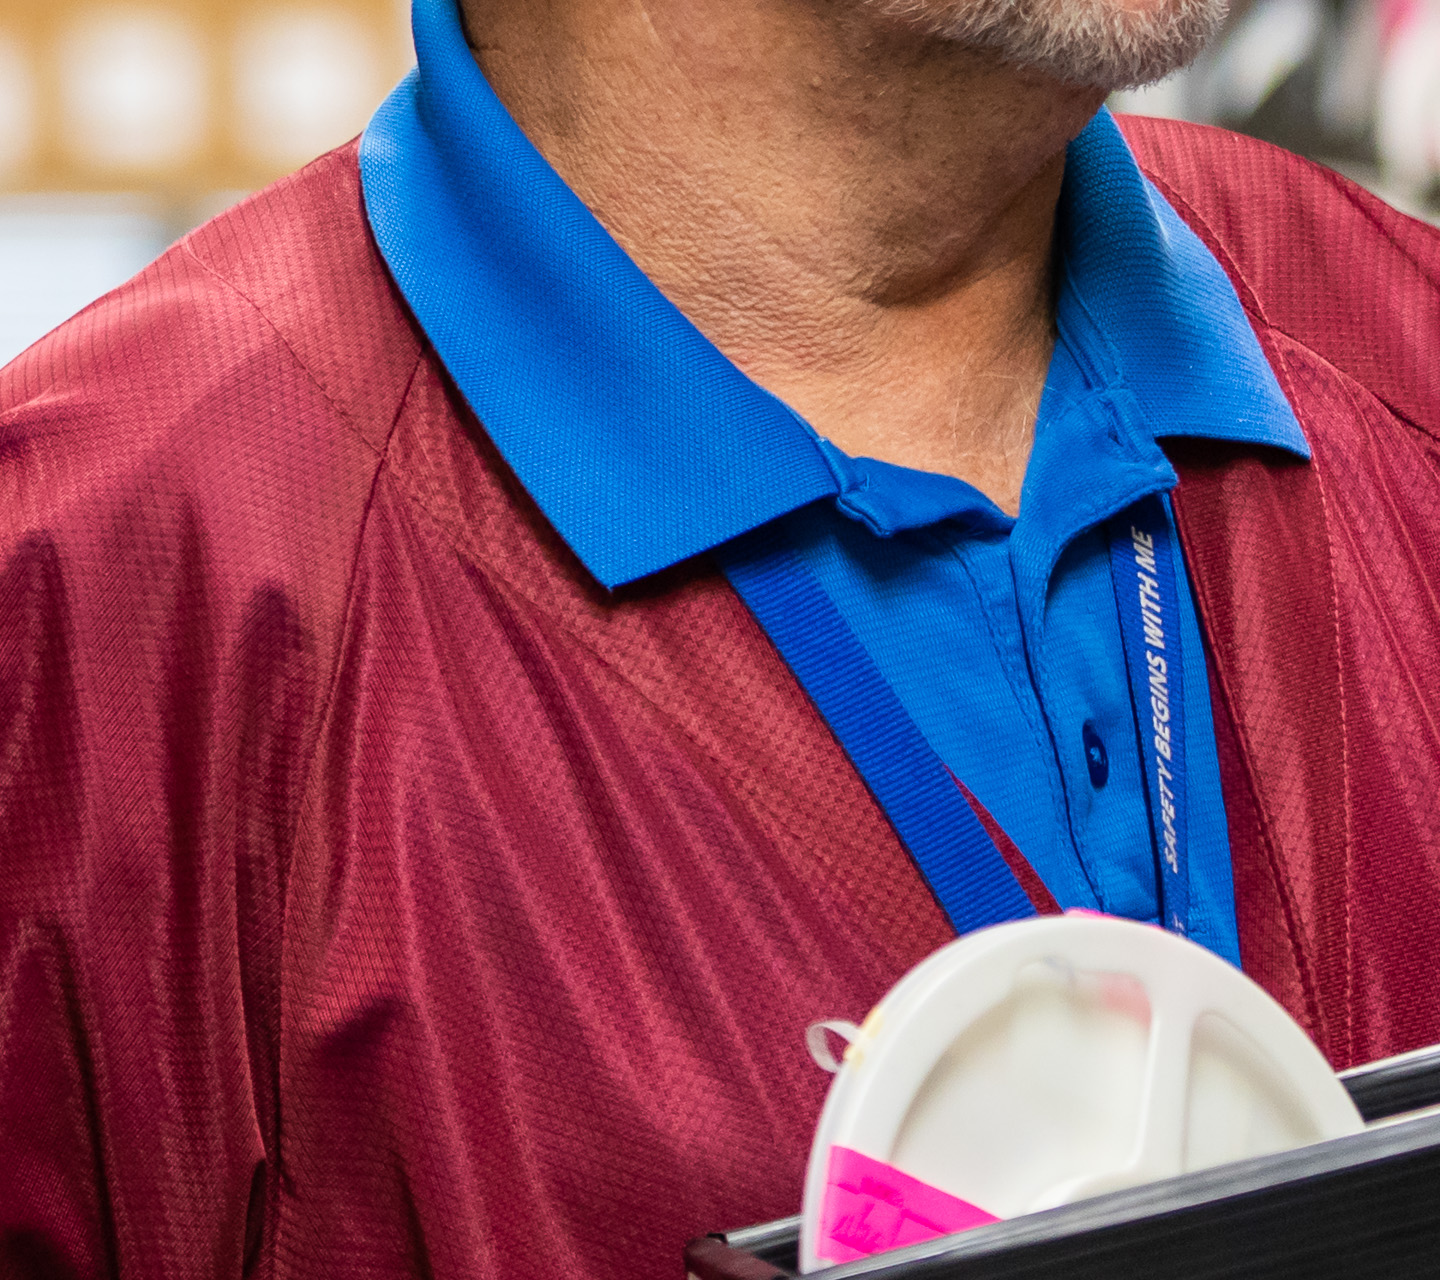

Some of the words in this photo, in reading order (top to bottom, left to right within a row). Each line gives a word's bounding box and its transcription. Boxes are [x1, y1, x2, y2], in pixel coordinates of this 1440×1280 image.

[1131, 526, 1155, 570] ME
[1136, 572, 1164, 650] WITH
[1147, 651, 1172, 761] BEGINS
[1154, 761, 1178, 874] SAFETY
